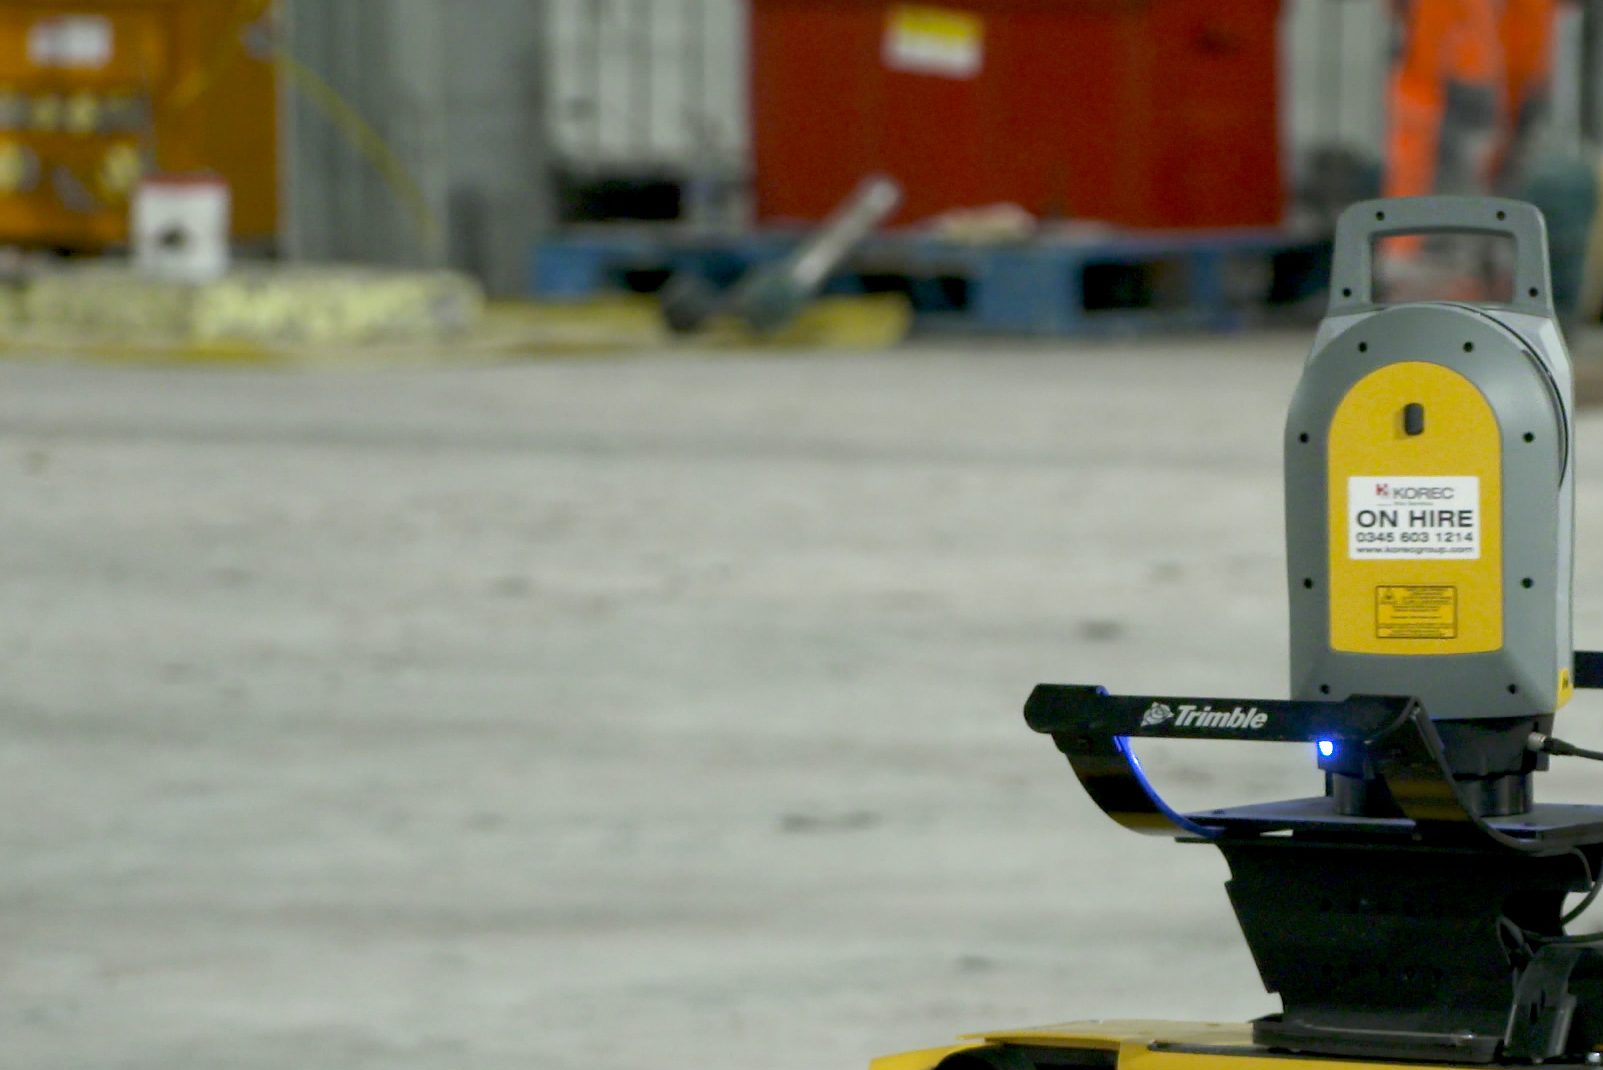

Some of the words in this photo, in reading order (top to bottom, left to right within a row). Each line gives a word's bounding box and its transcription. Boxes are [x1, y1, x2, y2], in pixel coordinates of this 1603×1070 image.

[1393, 488, 1454, 499] KOREC
[1357, 510, 1397, 528] ON
[1409, 510, 1473, 528] HIRE
[1356, 532, 1394, 542] 0345
[1401, 532, 1429, 542] 603
[1436, 532, 1473, 542] 1214
[1175, 704, 1268, 729] Trimble
